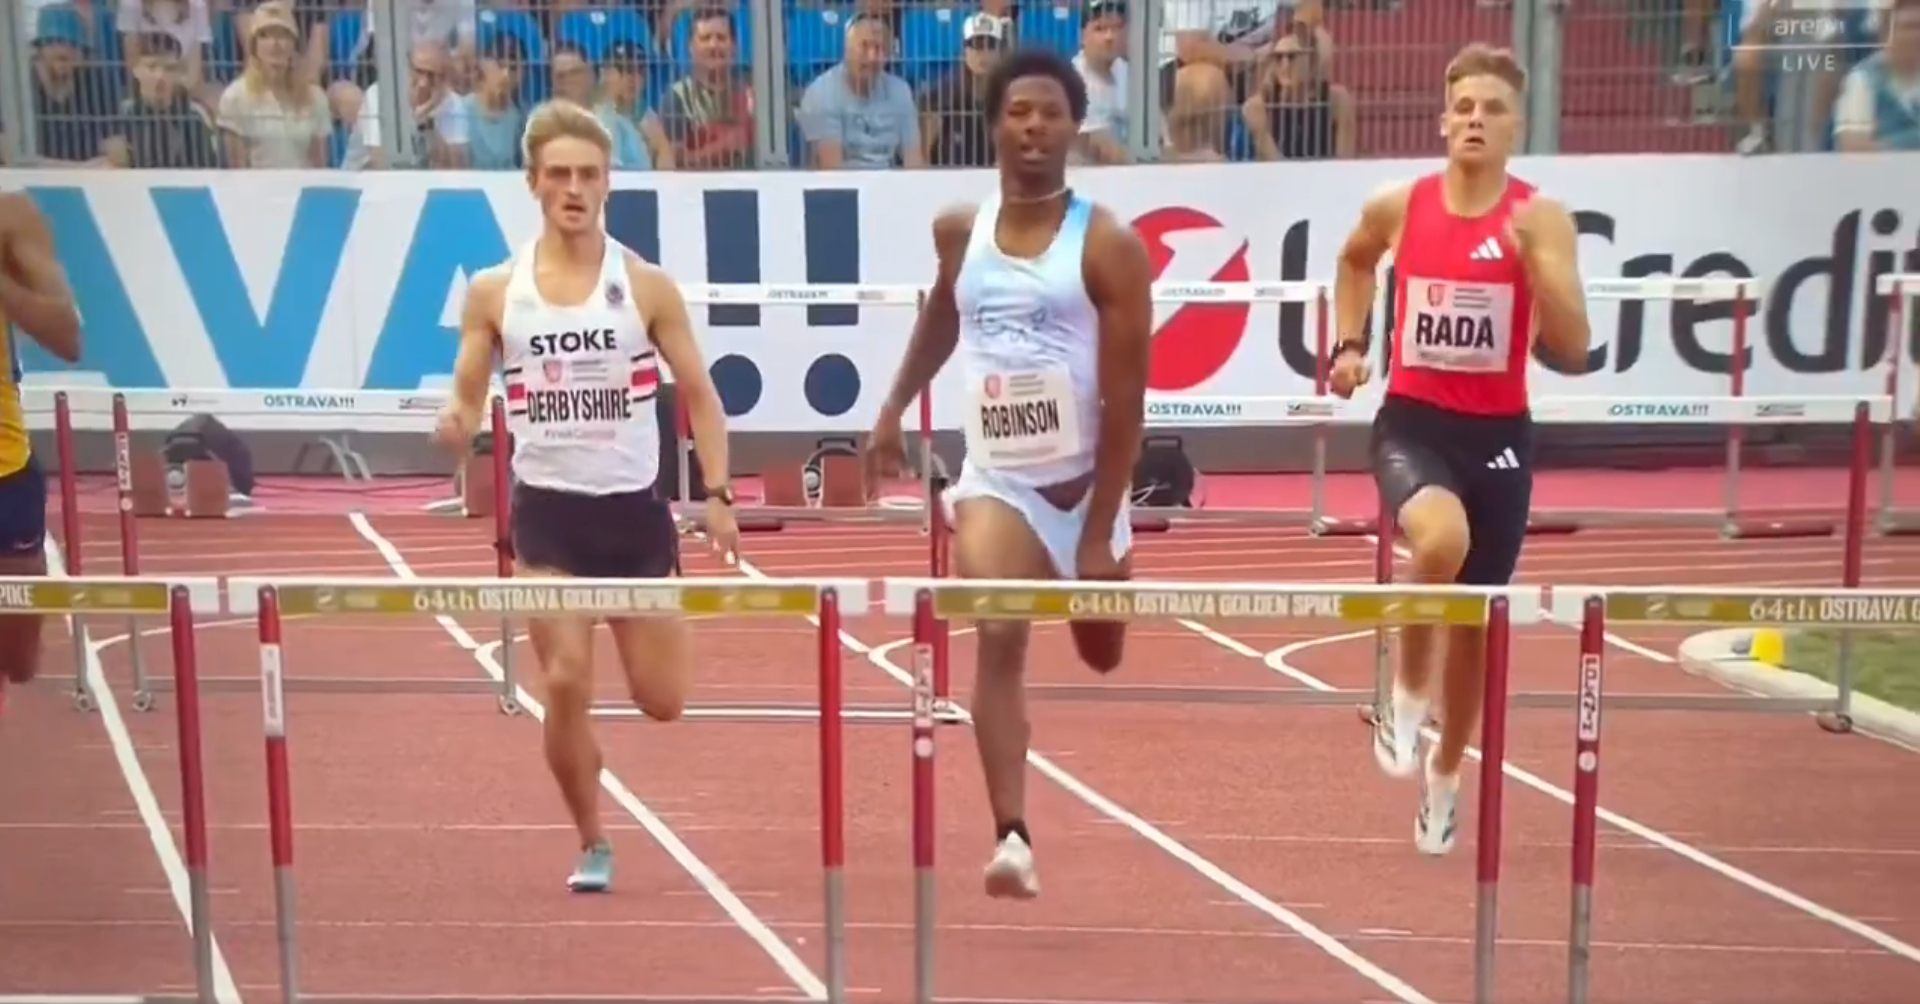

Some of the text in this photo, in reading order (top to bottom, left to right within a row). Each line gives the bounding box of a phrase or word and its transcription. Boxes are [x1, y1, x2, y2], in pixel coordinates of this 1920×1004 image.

[529, 328, 617, 356] STOKE
[1415, 311, 1494, 349] RADA
[527, 387, 631, 423] DERBYSHIRE
[981, 398, 1060, 439] ROBINSON
[413, 588, 475, 611] 64th
[478, 588, 561, 611] OSTRAVA
[1750, 597, 1815, 621] 64th
[1819, 597, 1907, 621] OSTRAVA
